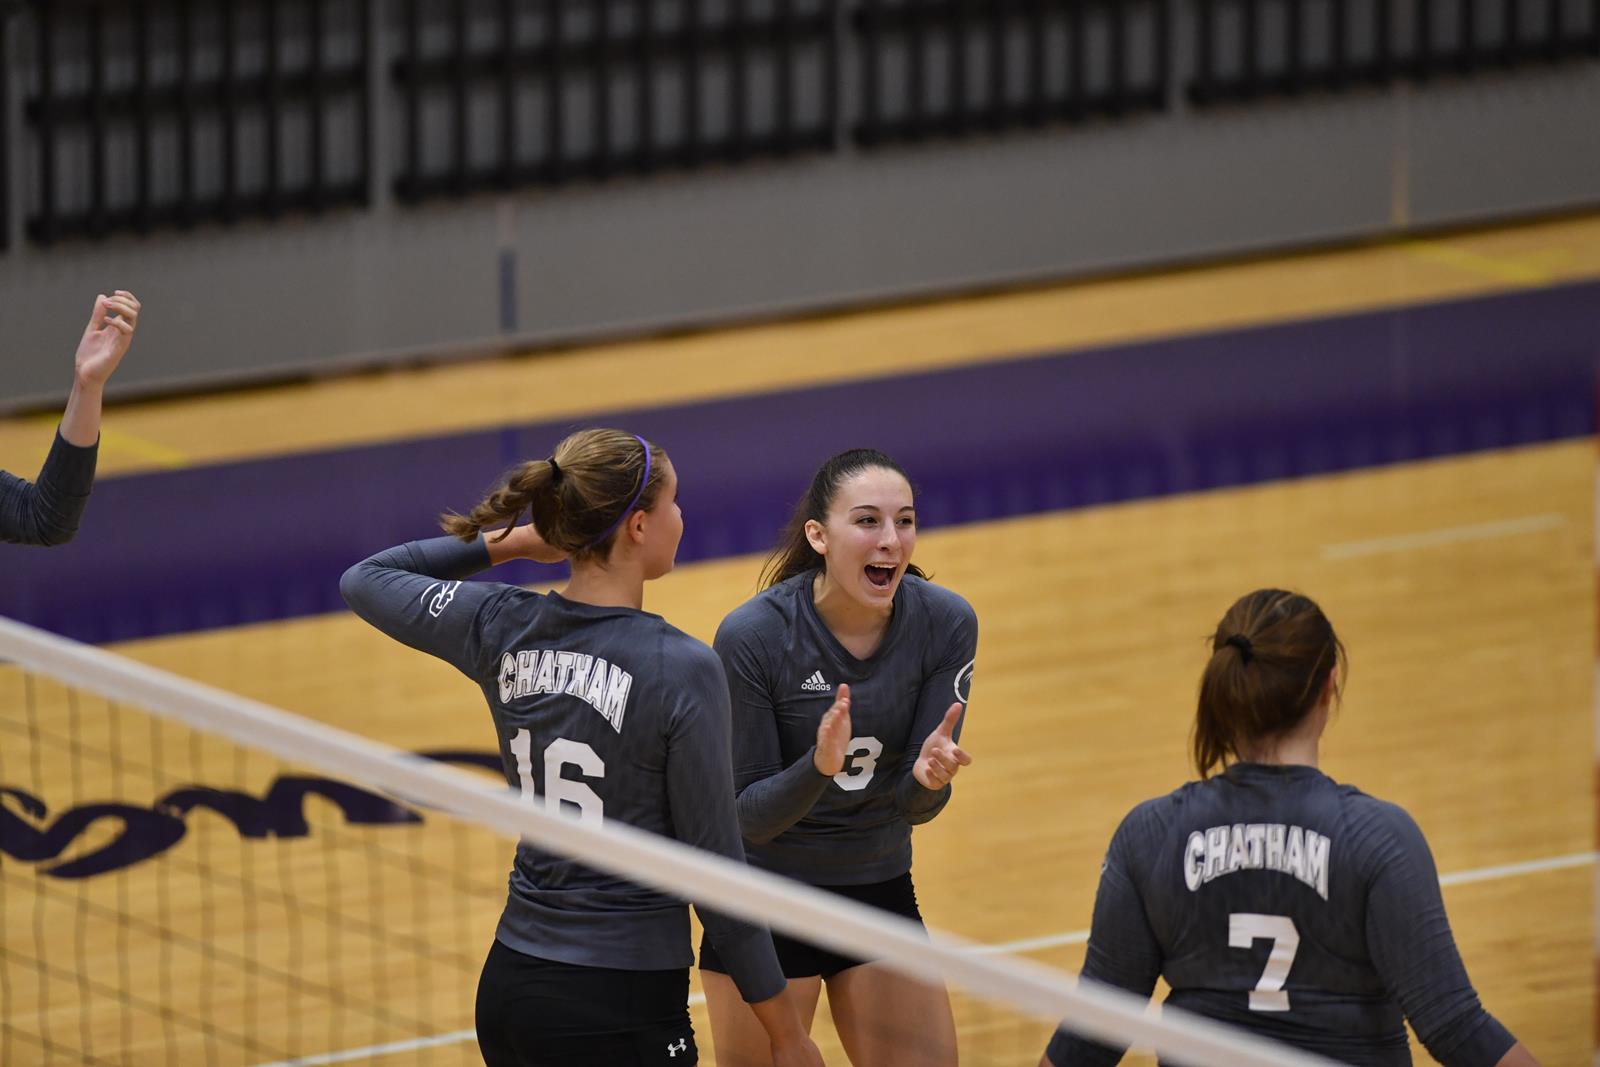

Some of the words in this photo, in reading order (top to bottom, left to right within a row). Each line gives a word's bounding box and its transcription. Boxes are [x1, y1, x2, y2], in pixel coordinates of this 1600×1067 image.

[498, 650, 633, 734] CHATHAM
[801, 682, 831, 691] adidas
[510, 728, 605, 829] 16
[833, 736, 884, 791] 3
[1184, 823, 1331, 901] CHATHAM
[1228, 913, 1300, 1011] 7
